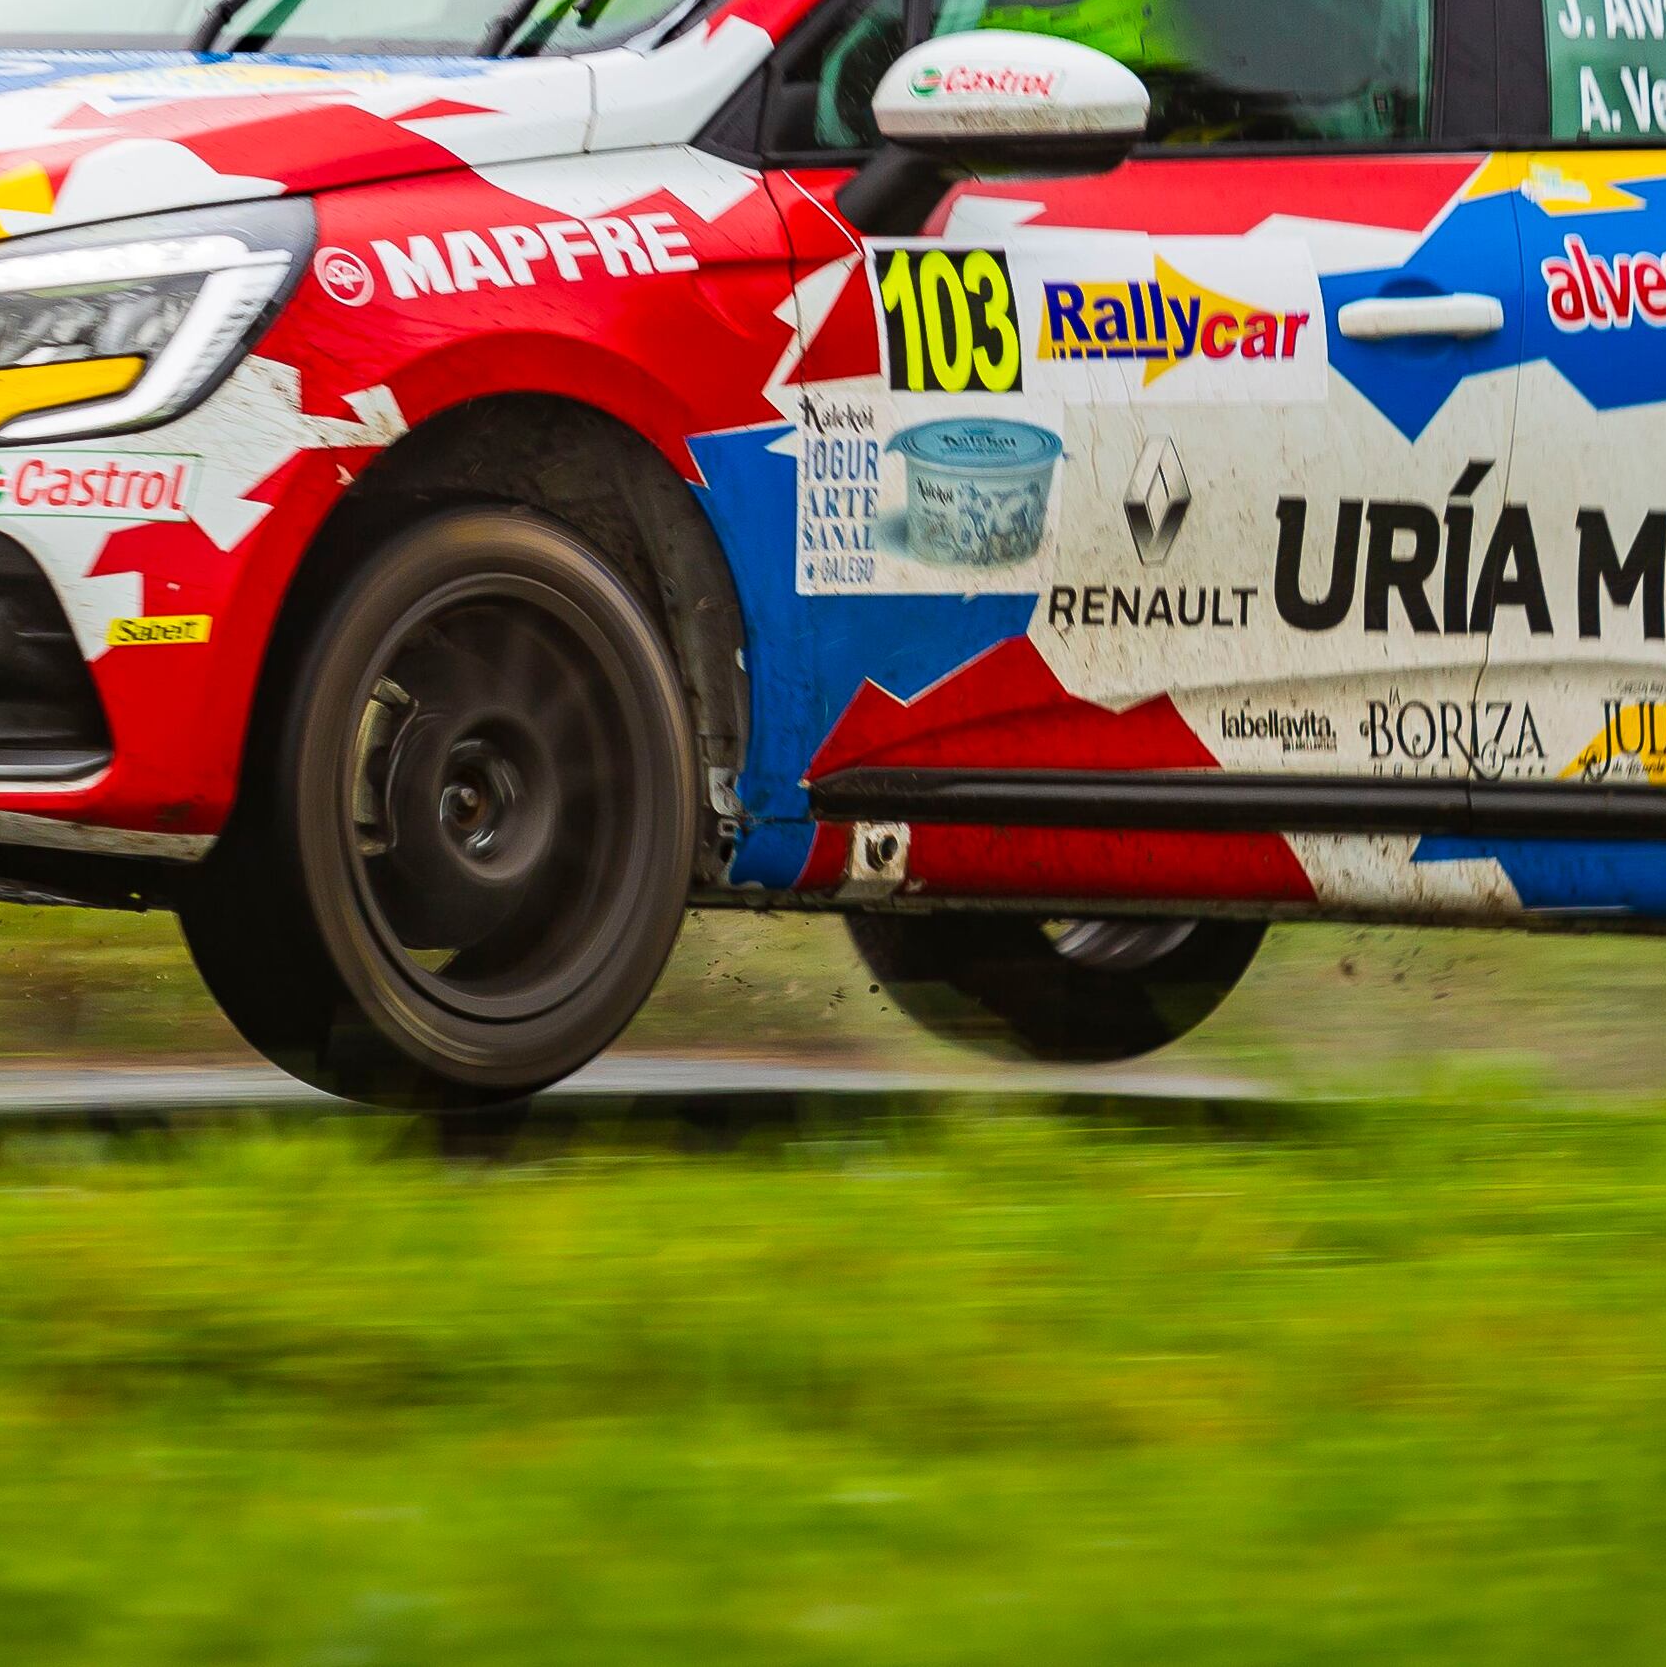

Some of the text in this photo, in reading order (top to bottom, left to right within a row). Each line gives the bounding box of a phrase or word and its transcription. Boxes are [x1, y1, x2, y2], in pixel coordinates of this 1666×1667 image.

[1579, 65, 1621, 133] A.
[369, 211, 700, 301] MAPFRE
[880, 248, 1021, 393] 103
[1042, 279, 1310, 360] Rallycar
[15, 458, 186, 512] Castrol
[804, 485, 879, 519] ARTE
[802, 521, 876, 552] SANAL
[1273, 459, 1553, 637] URÍA
[1048, 585, 1259, 629] RENAULT
[1363, 700, 1546, 774] BORIZA
